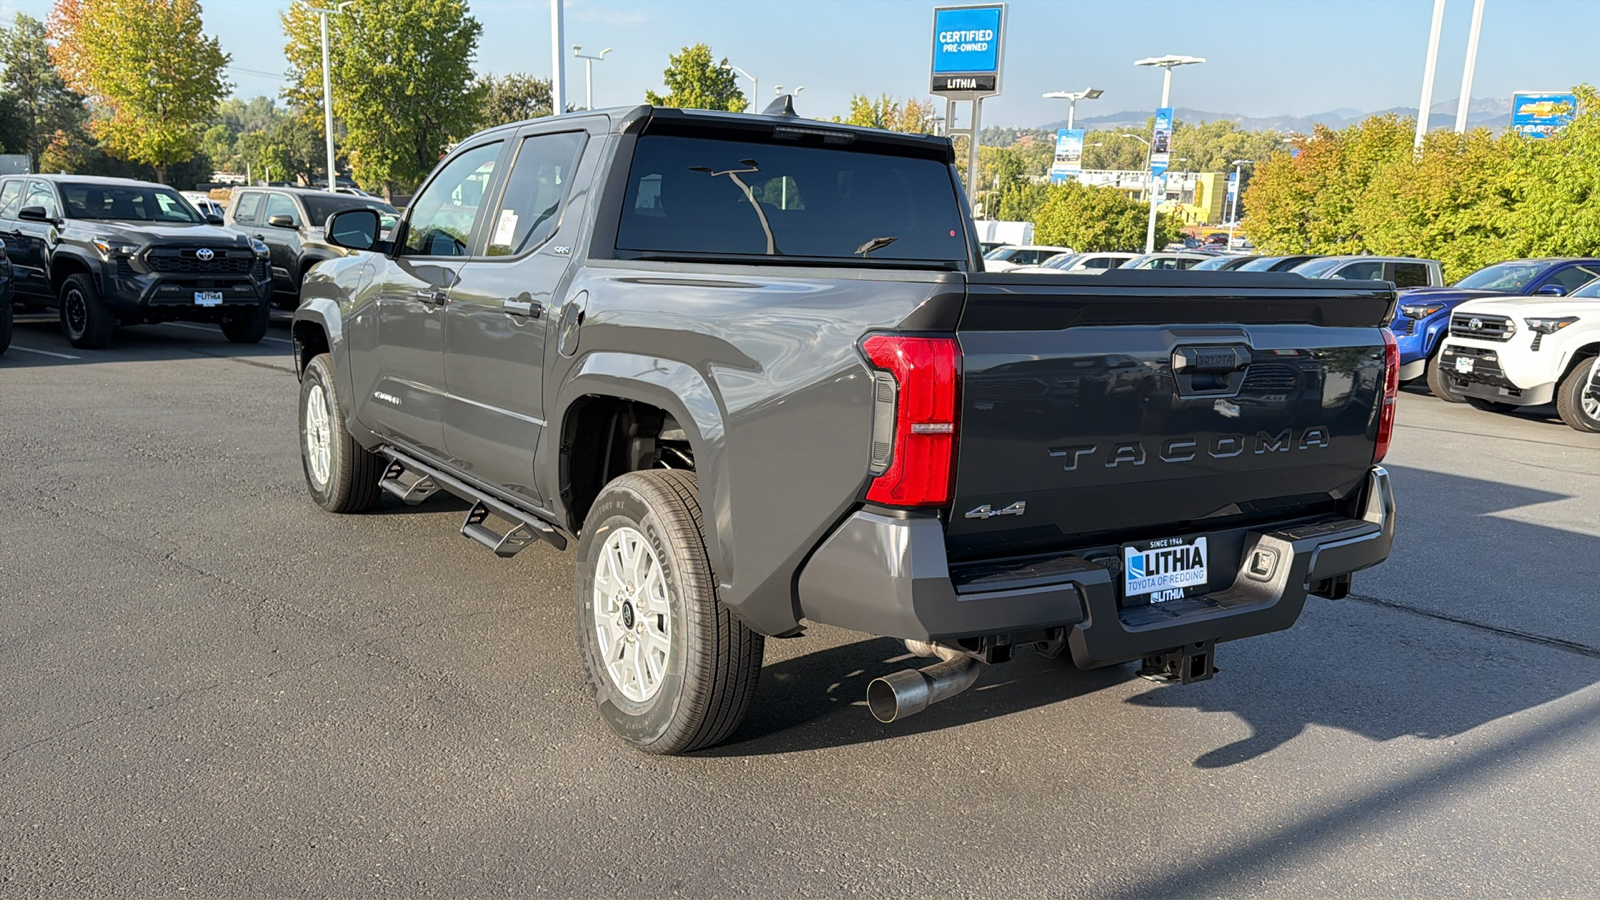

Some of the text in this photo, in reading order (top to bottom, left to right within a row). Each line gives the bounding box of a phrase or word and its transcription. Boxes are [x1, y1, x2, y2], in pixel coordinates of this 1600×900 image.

[940, 30, 993, 43] CERTIFIED
[943, 43, 988, 52] PRE-OWNED
[946, 78, 977, 88] LITHIA
[1198, 355, 1233, 365] TOYOTA
[1048, 426, 1330, 471] TACOMA
[1150, 538, 1183, 548] SINCE 1946
[1145, 547, 1204, 576] LITHIA
[1128, 569, 1205, 592] TOYOTA OF REDDING
[1158, 587, 1185, 602] LITHIA
